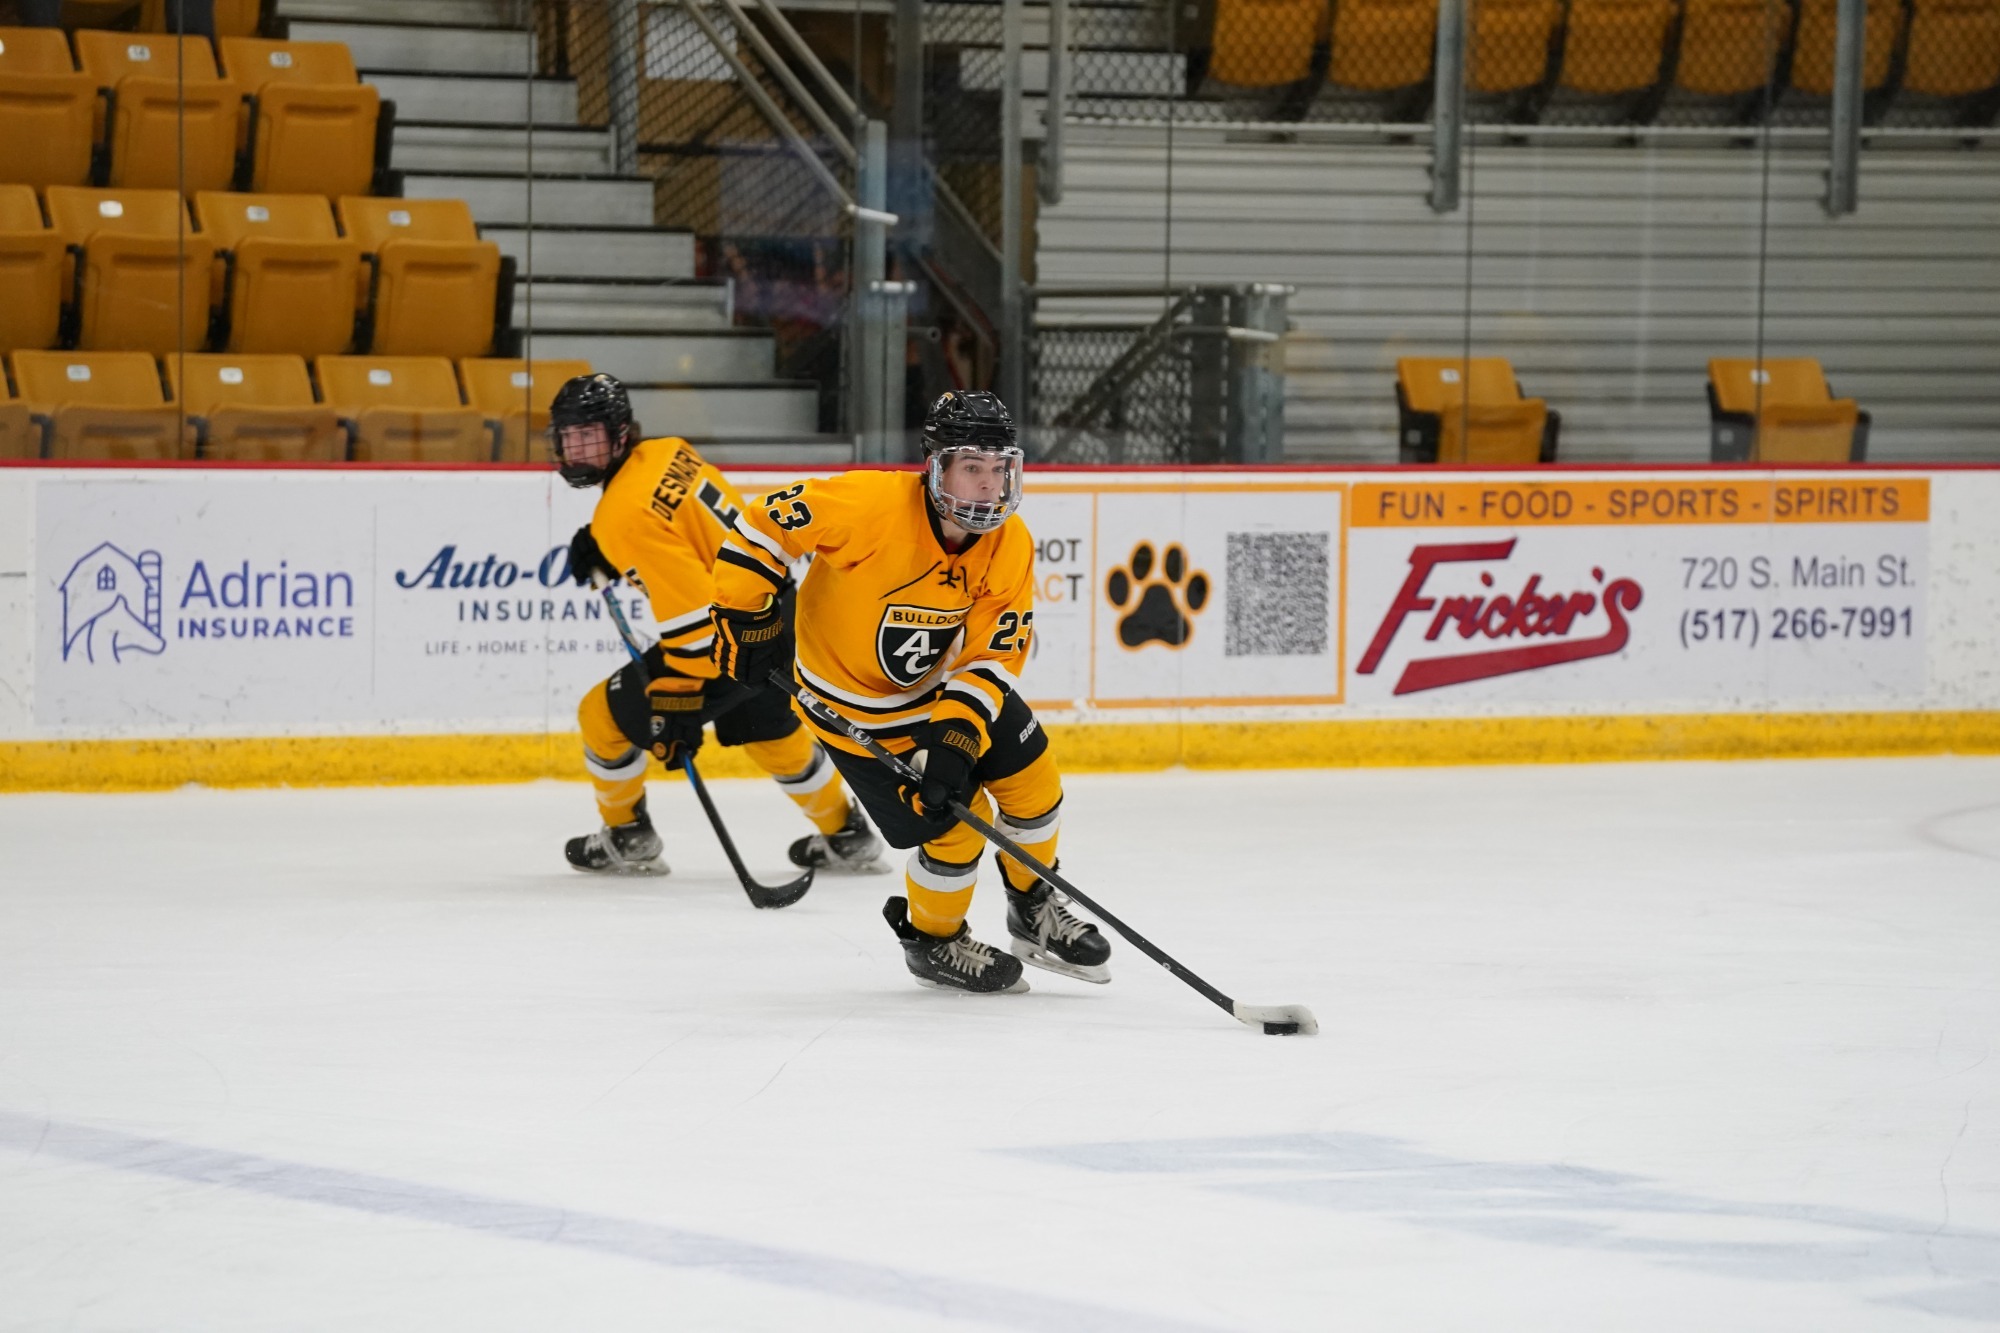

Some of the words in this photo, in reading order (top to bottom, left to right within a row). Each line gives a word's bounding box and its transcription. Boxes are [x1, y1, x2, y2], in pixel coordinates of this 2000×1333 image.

[651, 446, 703, 522] DESMAR
[1379, 491, 1444, 519] FUN
[1481, 490, 1573, 519] FOOD
[1608, 488, 1739, 517] SPORTS
[1774, 487, 1900, 516] SPIRITS
[764, 484, 813, 531] 23
[180, 560, 353, 608] Adrian
[395, 545, 634, 589] Auto-O
[1681, 557, 1738, 589] 720
[1750, 556, 1779, 589] S.
[1792, 555, 1864, 588] Main
[1876, 554, 1915, 587] St.
[178, 617, 354, 638] INSURANCE
[459, 600, 643, 620] INSURANE
[1680, 608, 1759, 649] (517)
[1772, 605, 1912, 639] 266-7991
[426, 640, 458, 655] LIFE
[478, 640, 526, 654] HOME
[546, 640, 577, 653] CAR
